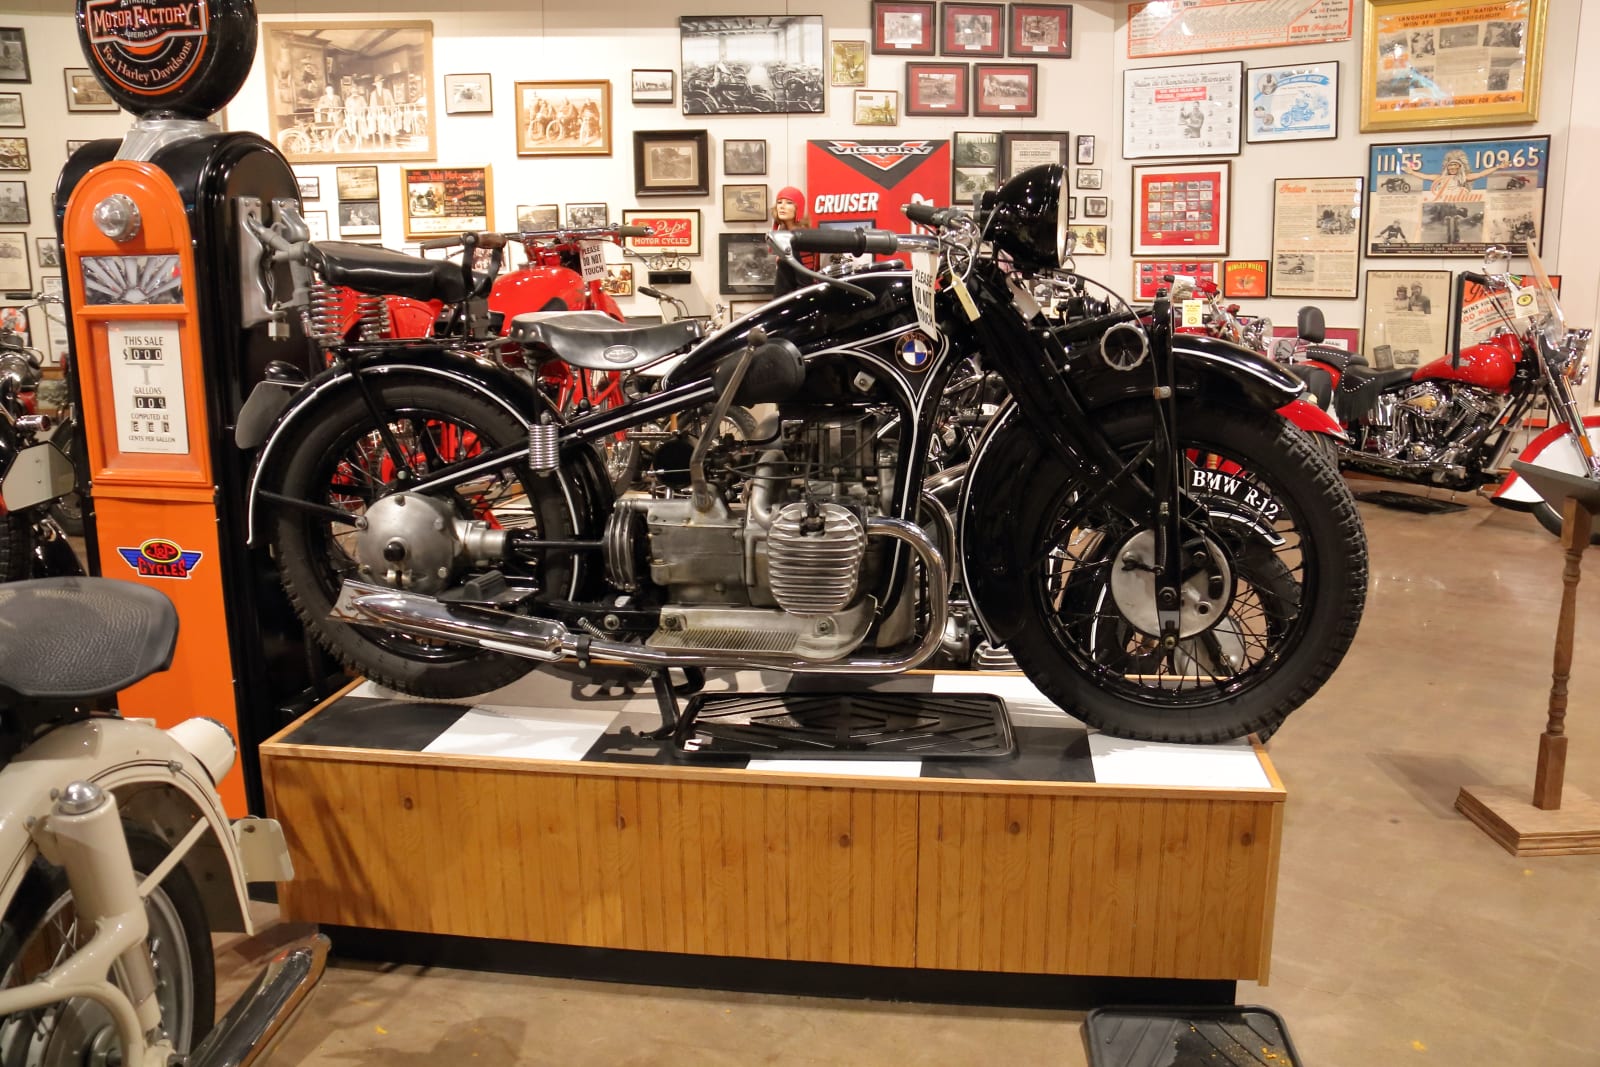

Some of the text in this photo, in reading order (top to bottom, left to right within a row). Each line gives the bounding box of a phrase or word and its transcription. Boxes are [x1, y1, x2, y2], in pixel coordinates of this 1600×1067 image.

[93, 3, 193, 32] MOTOR FACTORY
[124, 28, 158, 38] AMERICAN
[102, 40, 193, 85] For Harley Davidsons
[814, 192, 880, 214] CRUISER
[653, 219, 688, 237] Pope
[634, 237, 689, 246] MOTOR CYCLES
[582, 245, 601, 255] PLEASE
[583, 253, 602, 266] DO NOT
[584, 265, 604, 275] TOUCH
[914, 268, 933, 288] PLEASE
[914, 286, 932, 309] DO NOT
[1463, 303, 1479, 314] WINS
[123, 335, 164, 346] THIS SALE
[134, 386, 162, 395] GALLONS
[1191, 469, 1280, 520] BMW R-12
[137, 556, 187, 577] CYCLES
